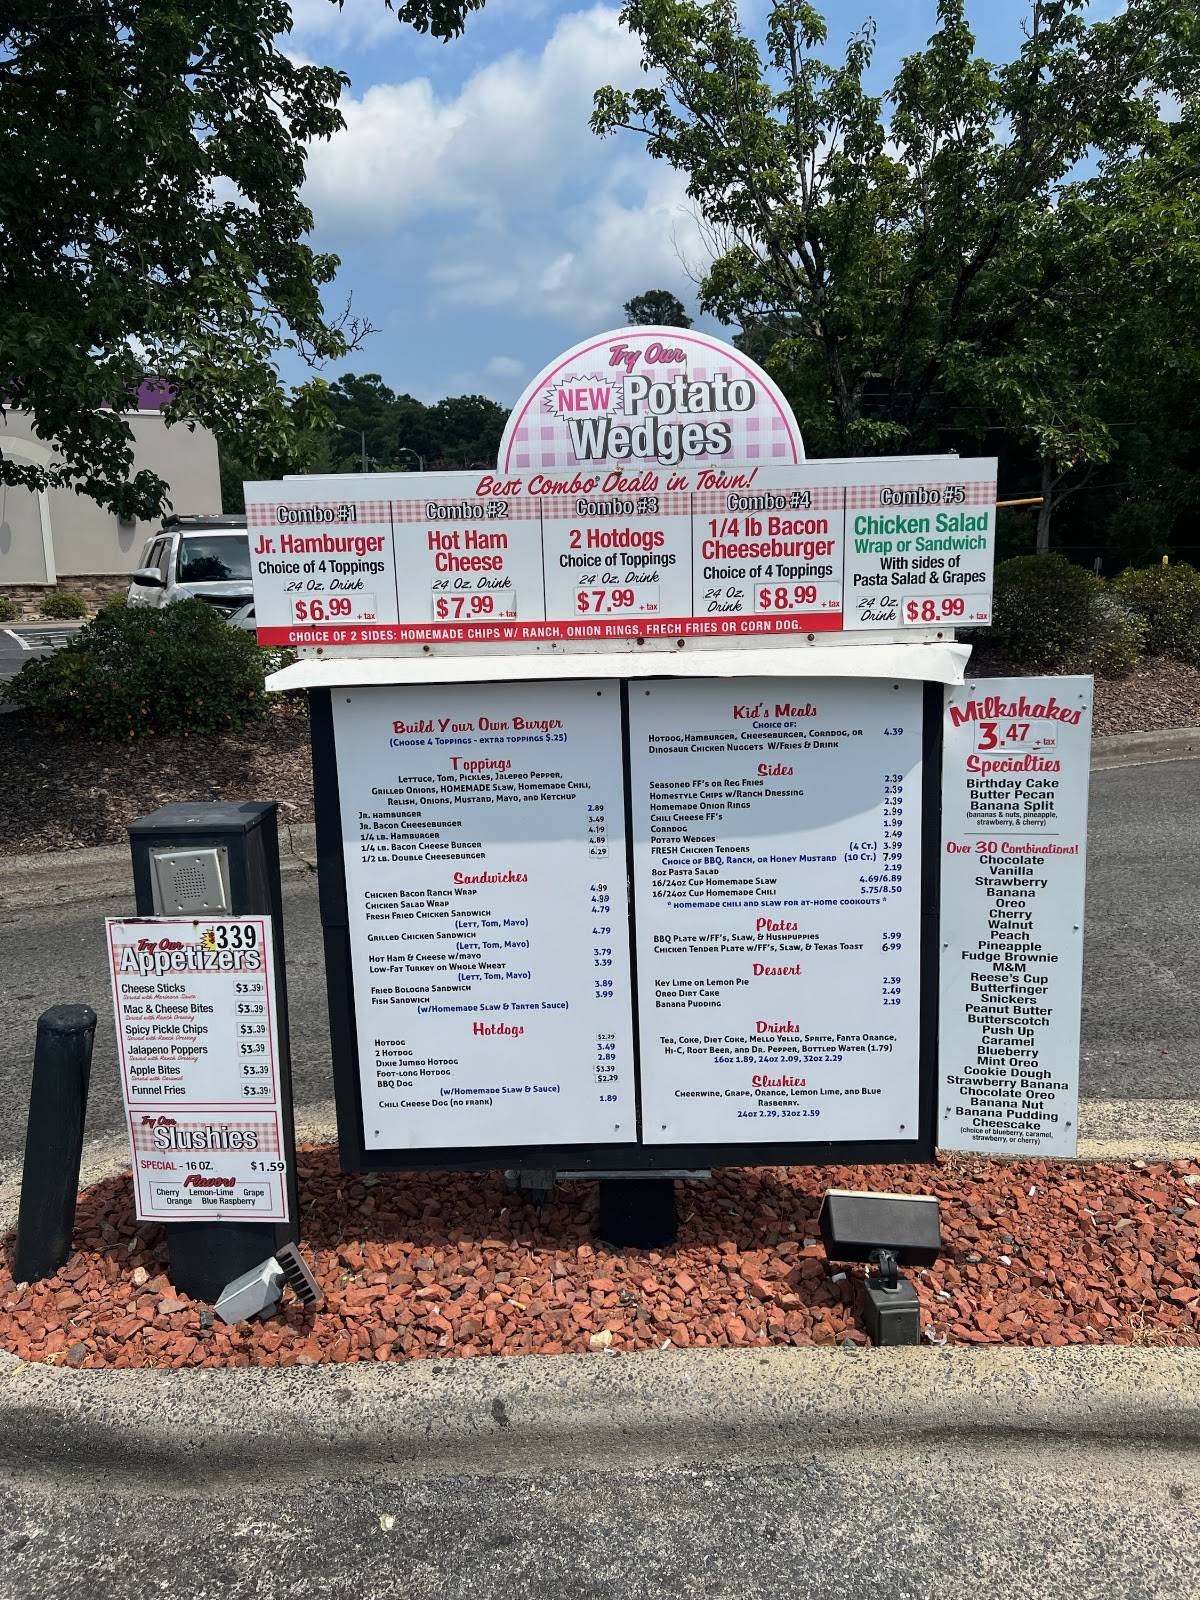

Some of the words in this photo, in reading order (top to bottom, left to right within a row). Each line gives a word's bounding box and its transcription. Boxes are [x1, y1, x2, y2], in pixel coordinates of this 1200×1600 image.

[609, 344, 641, 373] Try
[644, 342, 686, 365] Our
[558, 387, 611, 411] NEW
[623, 373, 755, 416] Potato
[569, 416, 731, 465] Wedges
[476, 475, 522, 496] Best
[528, 473, 597, 495] Combo
[603, 471, 658, 493] Deals
[667, 475, 688, 490] in
[696, 467, 759, 489] Town!
[727, 494, 786, 511] Combo
[789, 491, 812, 508] #4
[880, 488, 940, 506] Combo
[943, 486, 966, 502] #5
[277, 506, 334, 523] Combo
[337, 505, 356, 521] #1
[426, 502, 483, 520] Combo
[486, 502, 508, 518] #2
[576, 499, 634, 516] Combo
[637, 498, 659, 514] #3
[709, 518, 739, 538] 1/4
[745, 518, 762, 536] lb
[768, 518, 828, 536] Bacon
[854, 516, 930, 536] Chicken
[935, 512, 988, 532] Salad
[255, 536, 274, 554] Jr.
[281, 536, 385, 556] Hamburger
[428, 531, 460, 550] Hot
[465, 530, 508, 548] Ham
[570, 530, 581, 549] 2
[588, 528, 664, 550] Hotdogs
[855, 540, 893, 556] Wrap
[896, 540, 912, 552] or
[916, 536, 987, 552] Sandwich
[702, 540, 835, 560] Cheeseburger
[258, 560, 300, 574] Choice
[303, 560, 315, 572] of
[318, 561, 326, 572] 4
[329, 560, 384, 574] Toppings
[436, 553, 503, 572] Cheese
[560, 554, 601, 568] Choice
[605, 554, 617, 566] of
[620, 554, 676, 568] Toppings
[880, 557, 908, 570] With
[912, 558, 944, 569] sides
[948, 556, 960, 568] of
[854, 574, 888, 586] Pasta
[891, 572, 927, 584] Salad
[930, 573, 939, 584] &
[942, 571, 986, 585] Grapes
[578, 590, 634, 612] $7.99
[760, 586, 817, 609] $8.99
[295, 598, 351, 621] $6.99
[436, 596, 494, 618] $7.99
[907, 598, 964, 622] $8.99
[289, 632, 330, 642] CHOICE
[333, 632, 347, 641] OF
[350, 631, 357, 640] 2
[360, 630, 397, 641] SIDES:
[400, 629, 464, 640] HOMEMADE
[468, 628, 500, 638] CHIPS
[504, 628, 519, 638] W/
[522, 626, 564, 638] RANCH,
[567, 626, 601, 636] ONION
[605, 624, 643, 636] RINGS,
[646, 623, 682, 634] FRECH
[686, 622, 719, 632] FRIES
[722, 622, 737, 632] OR
[740, 622, 772, 632] CORN
[776, 620, 802, 630] DOG.
[733, 703, 769, 719] Kid's
[775, 704, 817, 717] Meals
[950, 696, 1082, 727] Milkshakes
[392, 720, 434, 733] Build
[438, 719, 475, 732] Your
[478, 718, 509, 730] Own
[512, 717, 563, 732] Burger
[884, 728, 903, 736] 4.39
[978, 723, 1030, 750] 3.47
[450, 757, 512, 772] Toppings
[757, 764, 794, 777] Sides
[967, 754, 1060, 777] Specialties
[967, 779, 1021, 789] Birthday
[1026, 779, 1059, 788] Cake
[970, 790, 1010, 799] Butter
[1015, 790, 1055, 799] Pecan
[947, 842, 971, 854] Over
[975, 841, 998, 853] 30
[1001, 842, 1078, 855] Combinations!
[980, 856, 1044, 865] Chocolate
[453, 871, 528, 884] Sandwiches
[990, 866, 1033, 875] Vanilla
[859, 875, 902, 883] 4.69/6.89
[975, 877, 1048, 888] Strawberry
[861, 886, 902, 894] 5.75/8.50
[591, 905, 610, 913] 4.79
[756, 918, 798, 932] Plates
[216, 925, 256, 949] 339
[138, 939, 156, 955] Try
[159, 939, 184, 950] Our
[978, 941, 1041, 952] Pineapple
[121, 946, 260, 976] Appetizers
[962, 951, 1000, 962] Fudge
[1005, 953, 1058, 962] Brownie
[753, 964, 802, 976] Dessert
[595, 980, 613, 988] 3.89
[883, 977, 901, 985] 2.39
[122, 984, 155, 993] Cheese
[157, 984, 185, 993] Sticks
[971, 983, 1048, 995] Butterfinger
[981, 994, 1036, 1005] Snickers
[124, 1005, 144, 1013] Mac
[146, 1005, 153, 1013] &
[156, 1005, 188, 1013] Cheese
[191, 1004, 213, 1013] Bites
[126, 1025, 150, 1035] Spicy
[153, 1025, 180, 1034] Pickle
[182, 1025, 208, 1034] Chips
[473, 1022, 524, 1037] Hotdogs
[756, 1021, 800, 1034] Drinks
[128, 1045, 168, 1055] Jalapeno
[171, 1046, 208, 1054] Poppers
[978, 1046, 1038, 1058] Blueberry
[130, 1066, 156, 1076] Apple
[158, 1065, 180, 1074] Bites
[752, 1075, 806, 1088] Slushies
[132, 1086, 162, 1095] Funnel
[164, 1086, 186, 1095] Fries
[973, 1118, 1041, 1130] Cheescake
[154, 1126, 258, 1149] Slushies
[141, 1161, 177, 1170] SPECIAL
[186, 1162, 196, 1170] 16
[199, 1161, 213, 1170] OZ.
[251, 1162, 284, 1172] $1.59
[184, 1175, 236, 1188] Flavors
[157, 1189, 179, 1197] Cherry
[244, 1189, 264, 1197] Grape
[219, 1198, 255, 1206] Raspberry
